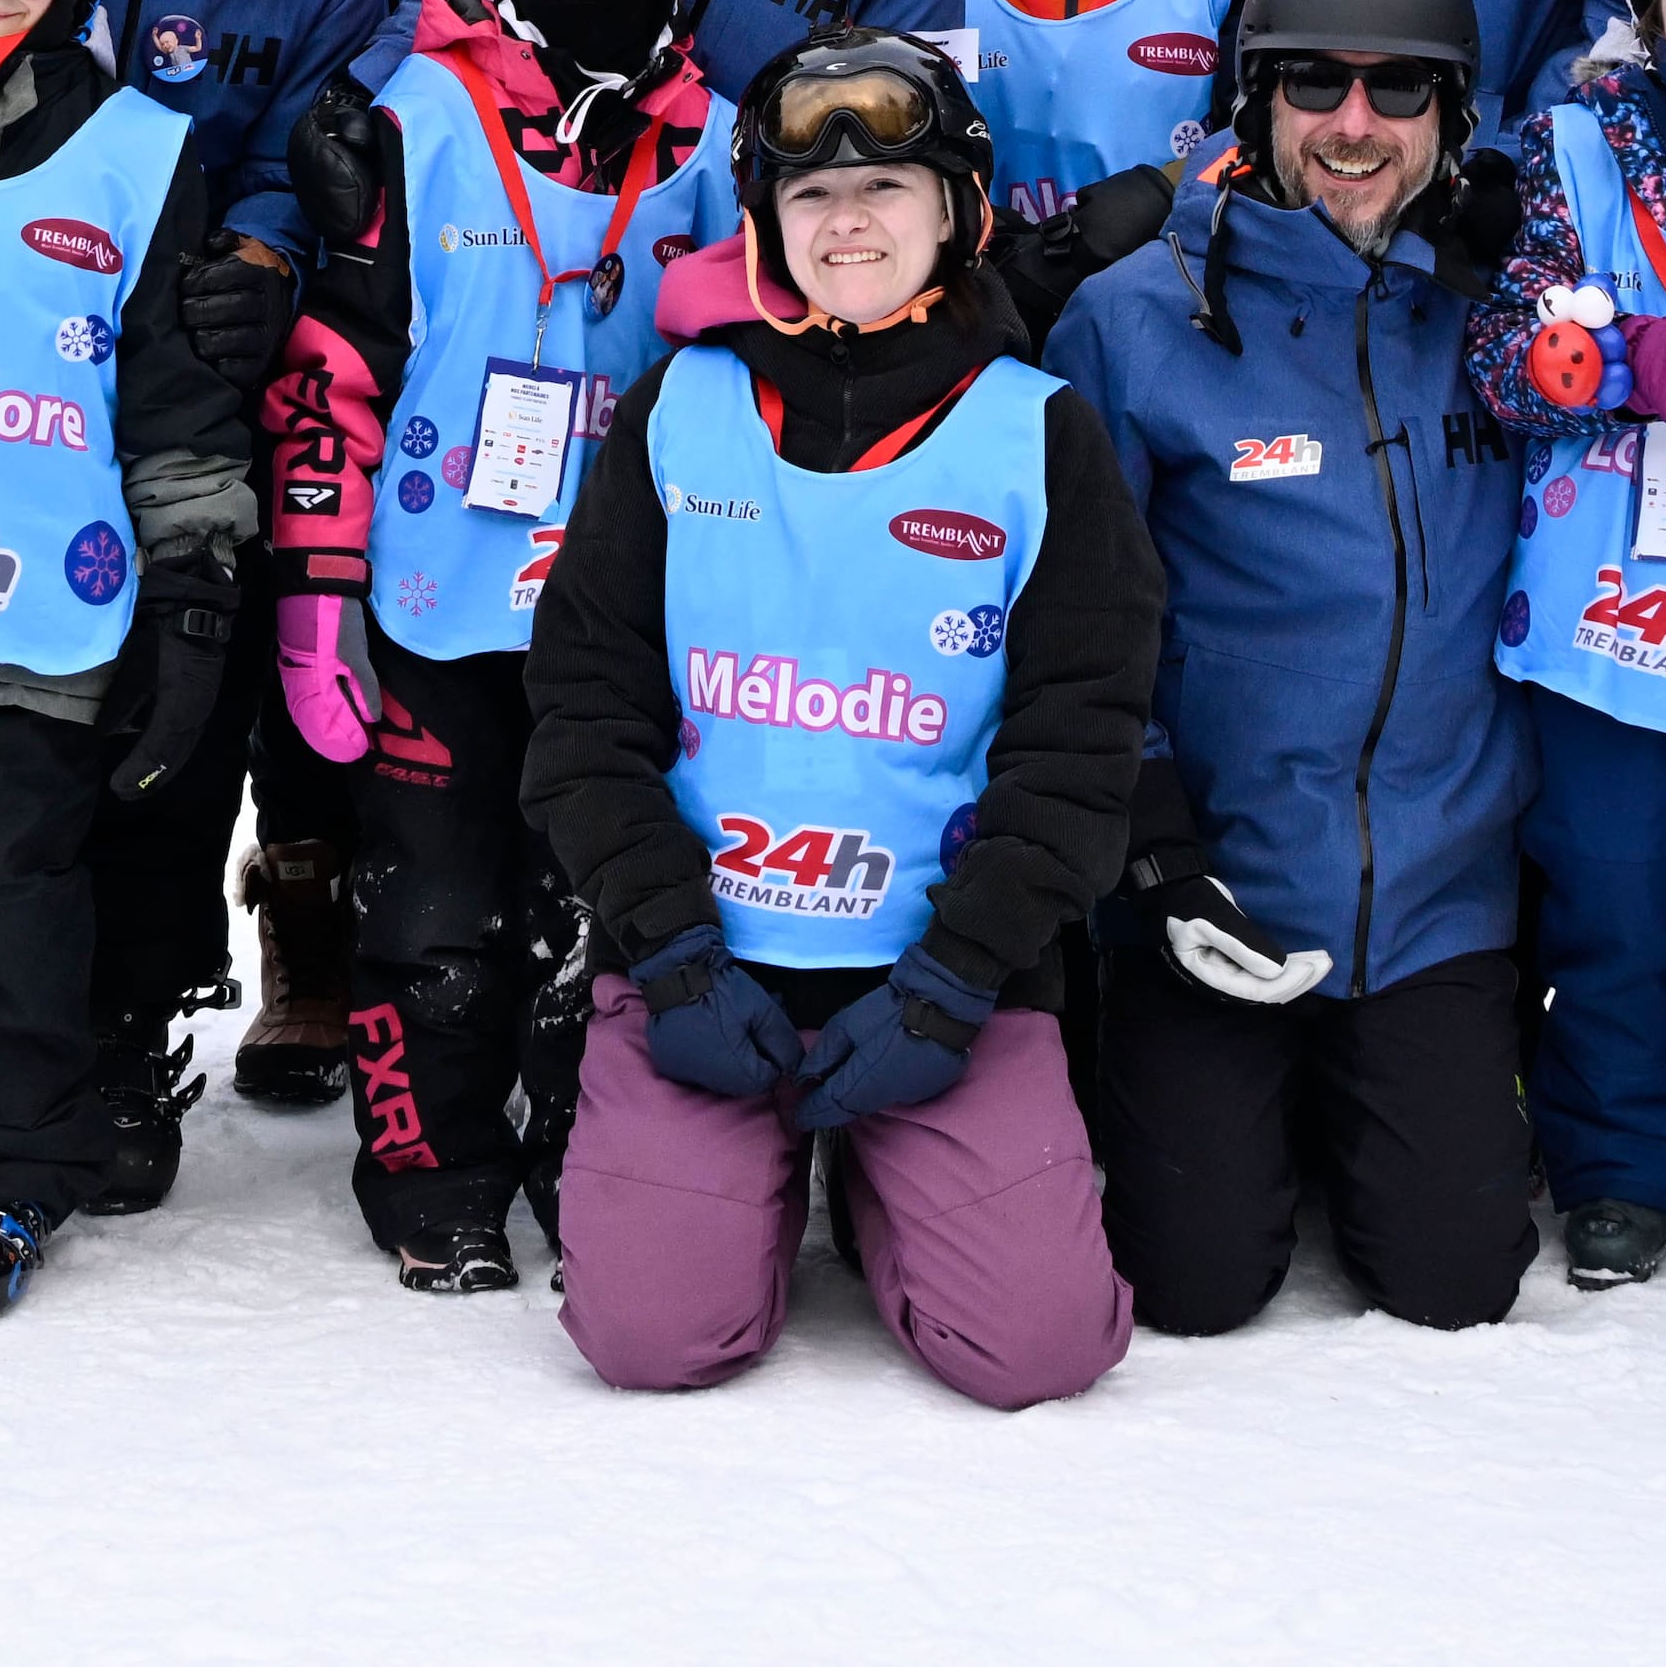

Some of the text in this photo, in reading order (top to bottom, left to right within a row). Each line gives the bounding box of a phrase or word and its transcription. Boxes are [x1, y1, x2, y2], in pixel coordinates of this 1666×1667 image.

[978, 51, 1008, 70] Life
[1138, 45, 1215, 71] TREMBLAN
[462, 226, 532, 248] Sun Lif
[1234, 435, 1321, 468] 24h
[685, 494, 761, 520] Sun Life
[901, 520, 1002, 556] TREMBLANT
[688, 646, 949, 745] Mélodie
[714, 817, 893, 892] 24h
[709, 873, 878, 916] TREMBLANT
[349, 1003, 421, 1153] FXR
